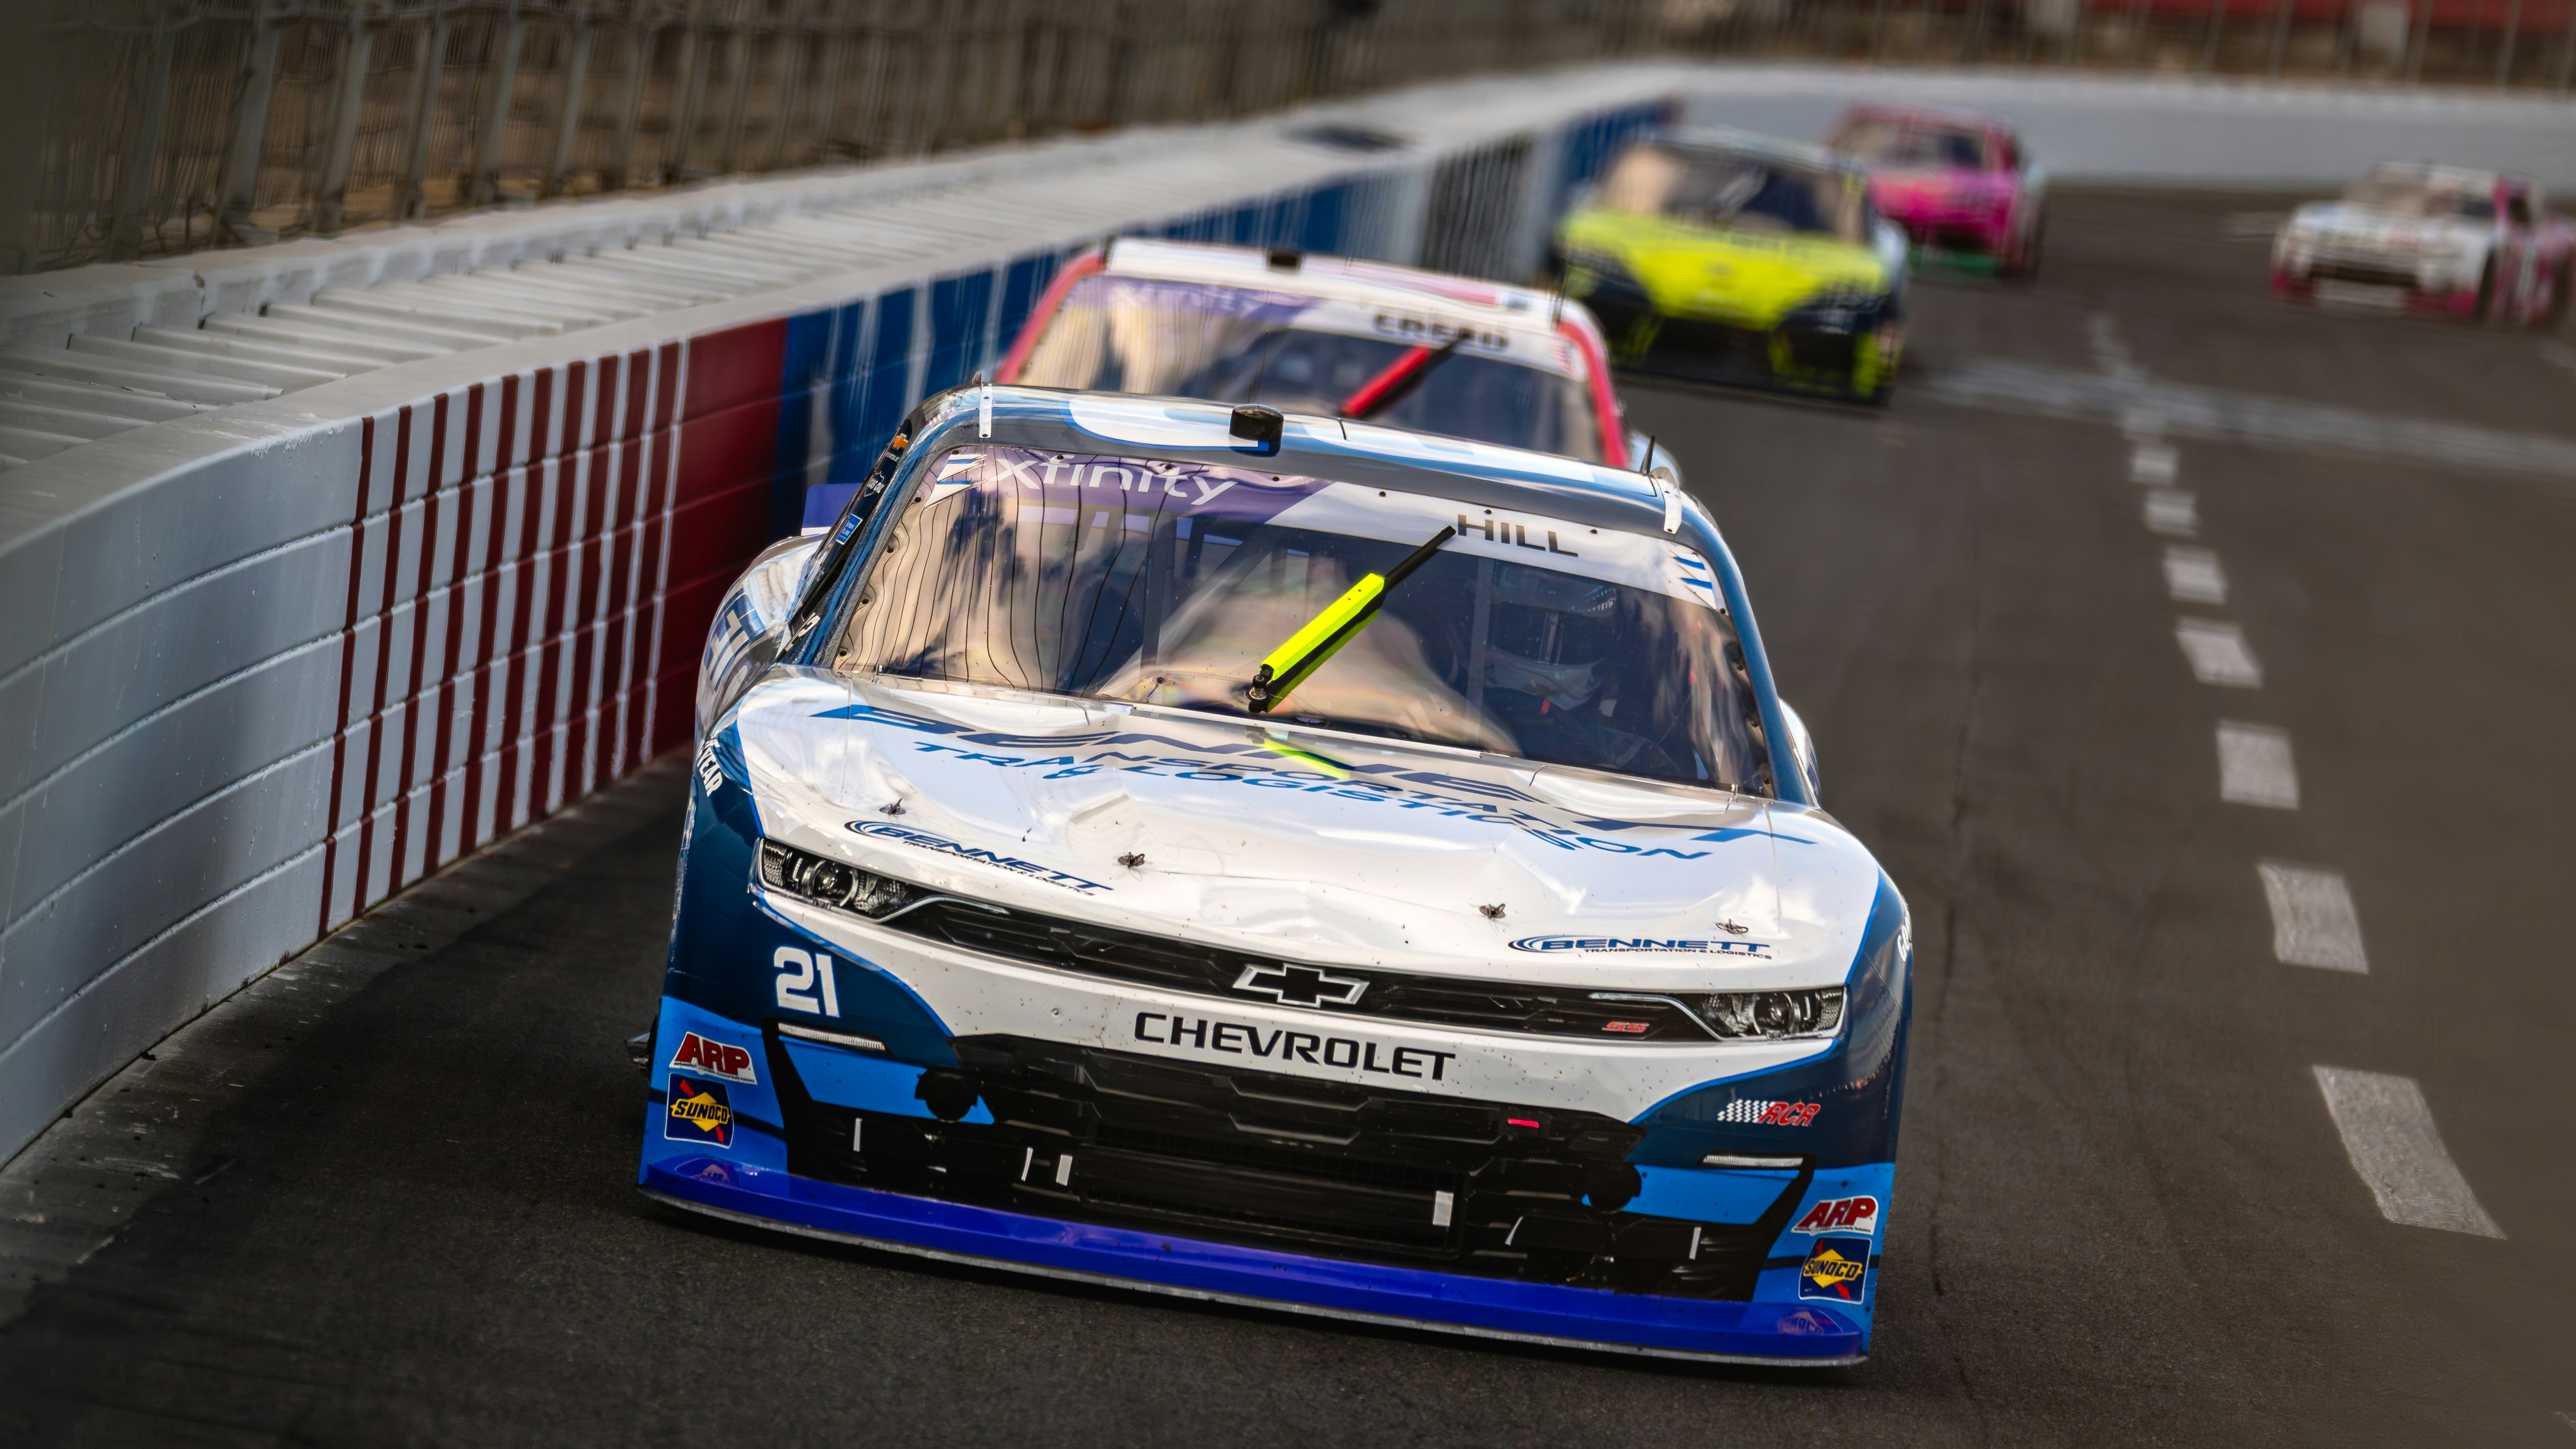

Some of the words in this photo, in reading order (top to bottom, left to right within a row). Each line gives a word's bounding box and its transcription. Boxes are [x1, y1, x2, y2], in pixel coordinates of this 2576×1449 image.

[985, 454, 1239, 506] xfinity
[1457, 514, 1579, 558] HILL
[914, 741, 1714, 860] TRANSPORTATION
[1119, 766, 1583, 851] LOGISTICS
[868, 826, 1114, 891] BENNETT
[1540, 939, 1770, 953] BENNETT
[1710, 949, 1772, 960] LOGISTICS
[774, 946, 840, 1017] 21
[675, 1033, 750, 1076] ARP
[1134, 1011, 1456, 1081] CHEVROLET
[673, 1101, 728, 1122] SUNOCO
[1758, 1101, 1821, 1127] RCR
[1797, 1197, 1876, 1227] ARP
[1804, 1259, 1860, 1279] SUNOCO
